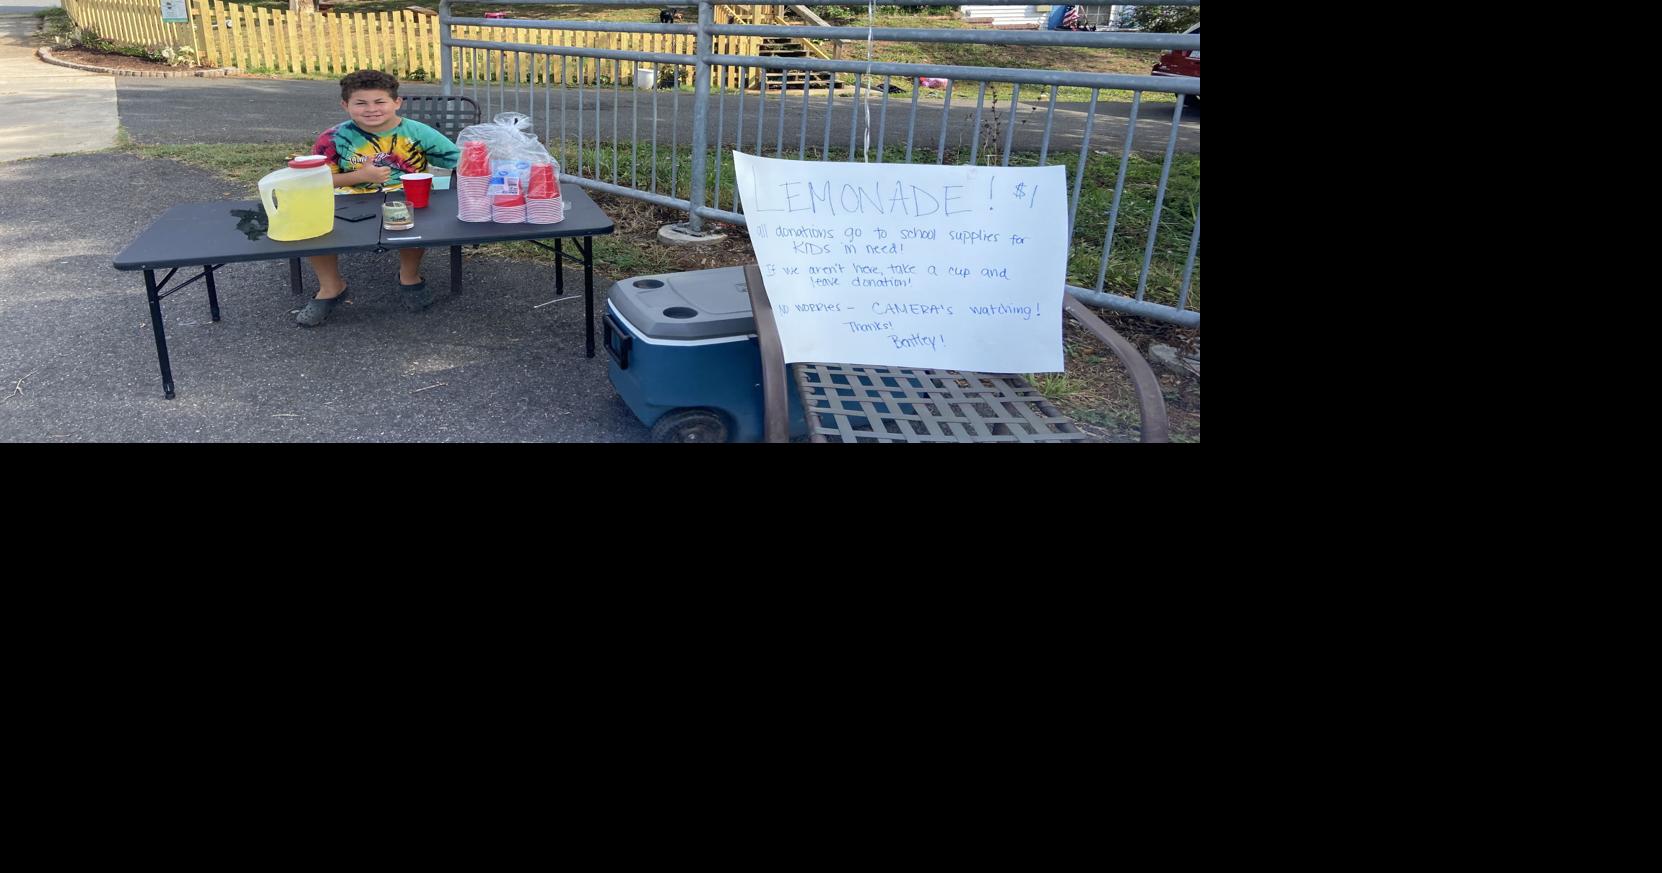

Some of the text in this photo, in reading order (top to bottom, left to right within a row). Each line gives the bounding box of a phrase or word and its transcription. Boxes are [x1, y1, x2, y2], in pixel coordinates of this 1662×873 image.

[752, 165, 972, 217] LEMONADE
[775, 224, 834, 239] donations
[844, 226, 862, 240] go
[873, 226, 888, 239] to
[900, 227, 936, 241] school
[949, 229, 1000, 244] supplies
[1009, 233, 1030, 246] for
[840, 241, 857, 254] in
[865, 242, 904, 254] need!
[782, 265, 799, 275] we
[808, 262, 845, 275] aren't
[852, 262, 883, 276] here,
[887, 263, 917, 275] take
[927, 264, 938, 277] a
[948, 265, 971, 279] cup
[980, 267, 1011, 281] and
[809, 276, 913, 288] leave donation!
[968, 302, 1041, 321] watching!
[841, 320, 893, 334] Thanks!
